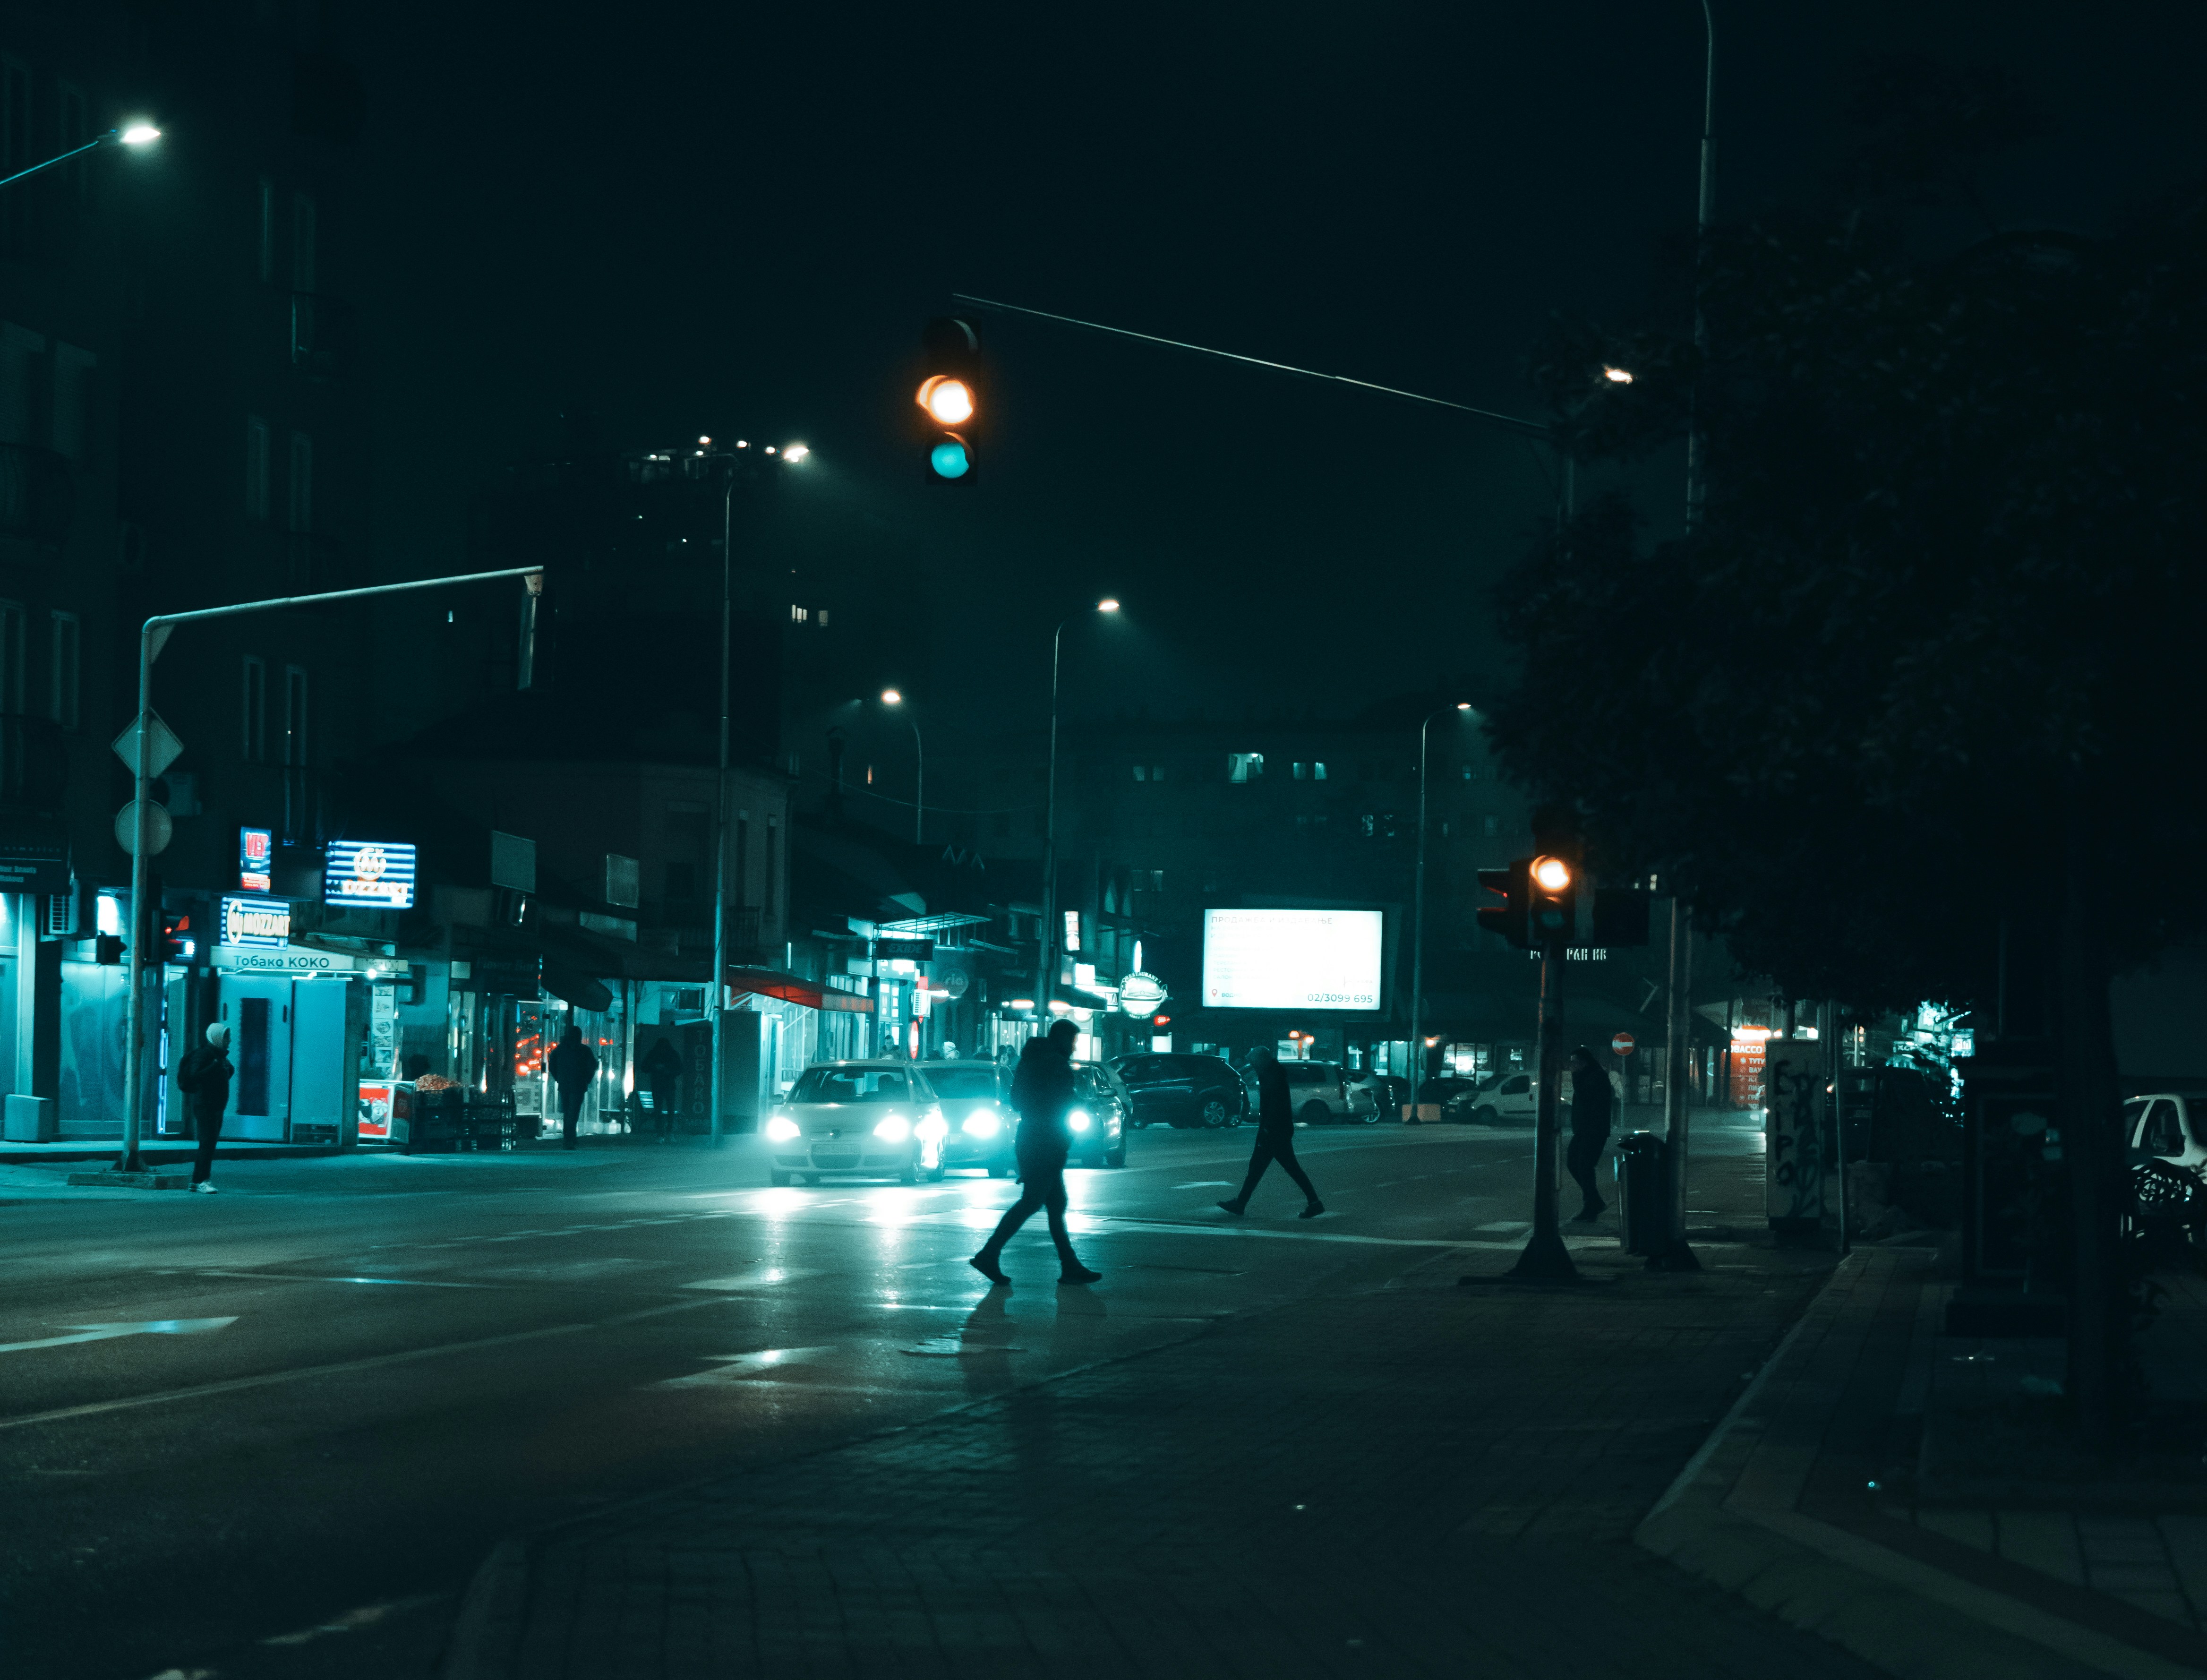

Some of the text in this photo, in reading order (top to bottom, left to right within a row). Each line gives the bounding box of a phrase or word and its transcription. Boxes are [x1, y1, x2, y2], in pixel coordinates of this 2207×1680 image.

[243, 912, 290, 936] MOZZART
[233, 955, 329, 968] Тобако КОКО
[1307, 993, 1373, 1003] 02/3099 695
[1731, 1045, 1763, 1054] BACCO
